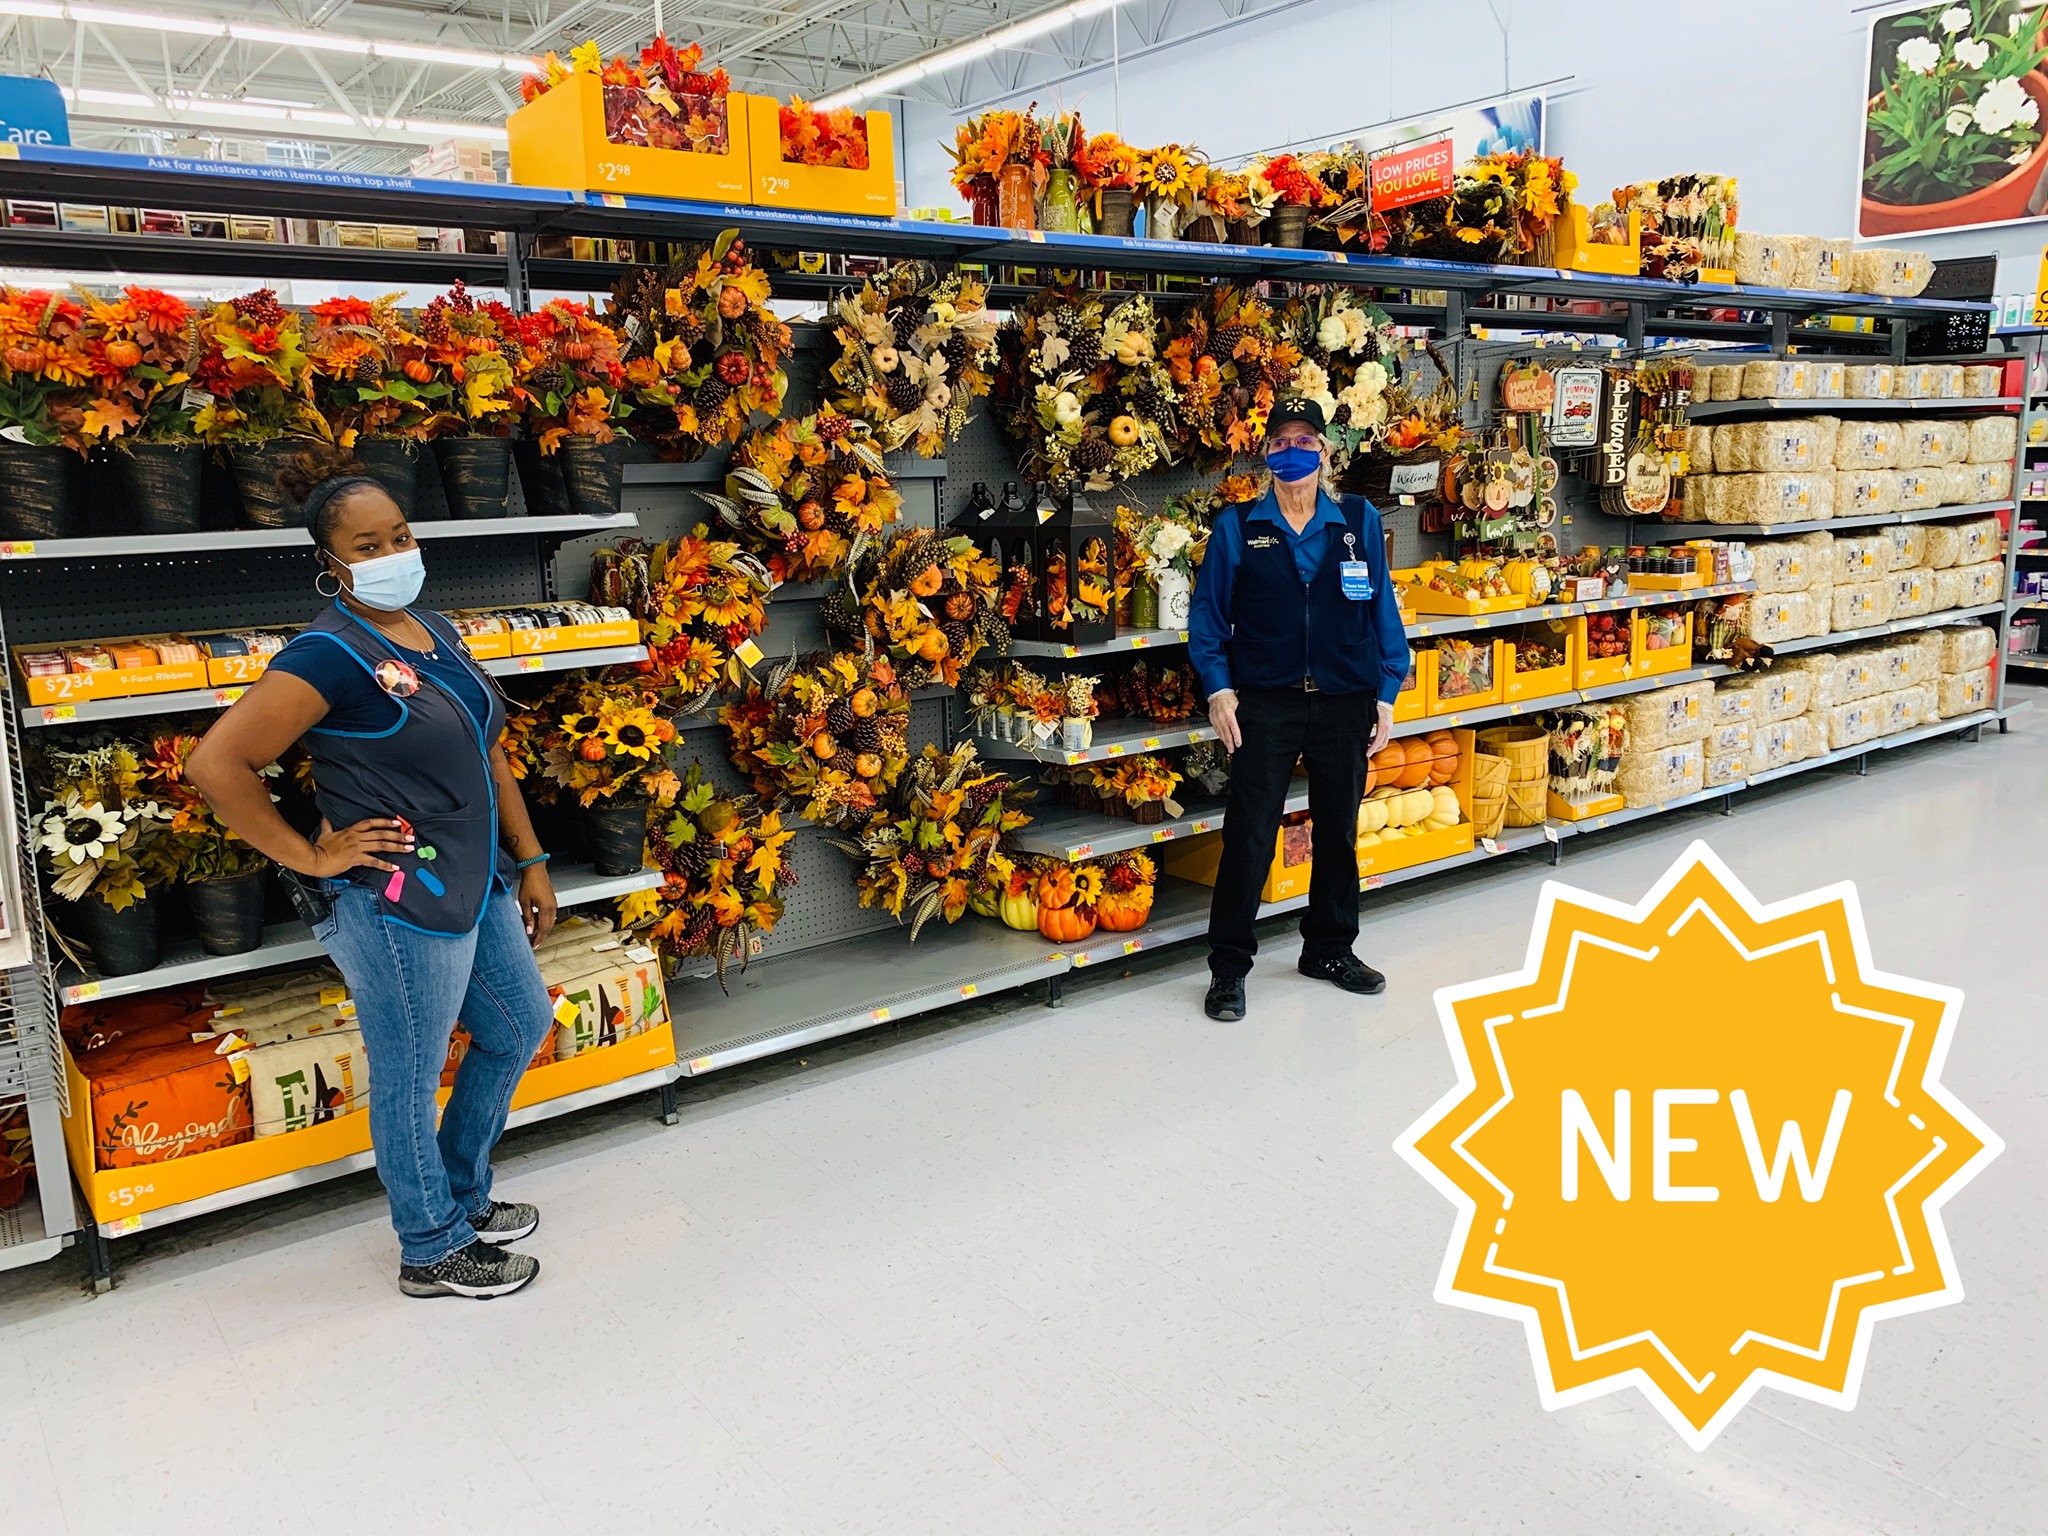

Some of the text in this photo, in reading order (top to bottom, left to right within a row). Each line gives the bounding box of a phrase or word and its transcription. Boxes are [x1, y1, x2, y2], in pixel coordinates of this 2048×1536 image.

[0, 120, 52, 145] are
[147, 158, 416, 189] Ask for assistance with items on the top shelf.
[1375, 150, 1449, 182] LOW PRICES
[717, 181, 743, 191] Garland
[1375, 167, 1442, 196] YOU LOVE.
[724, 206, 741, 215] Ask
[741, 208, 754, 216] for
[755, 210, 798, 220] assistance
[798, 212, 817, 222] with
[817, 214, 840, 223] items
[852, 218, 867, 226] the
[867, 220, 881, 229] top
[881, 220, 903, 229] shelf.
[1565, 385, 1595, 395] PUMPKIN
[1606, 379, 1631, 484] BLESSED
[1396, 472, 1433, 485] Welcome
[1246, 538, 1270, 546] Walmart
[576, 628, 630, 640] 9-Foot Ribbons
[120, 670, 194, 685] 9-Foot Ribbons
[121, 1095, 242, 1161] Beyond
